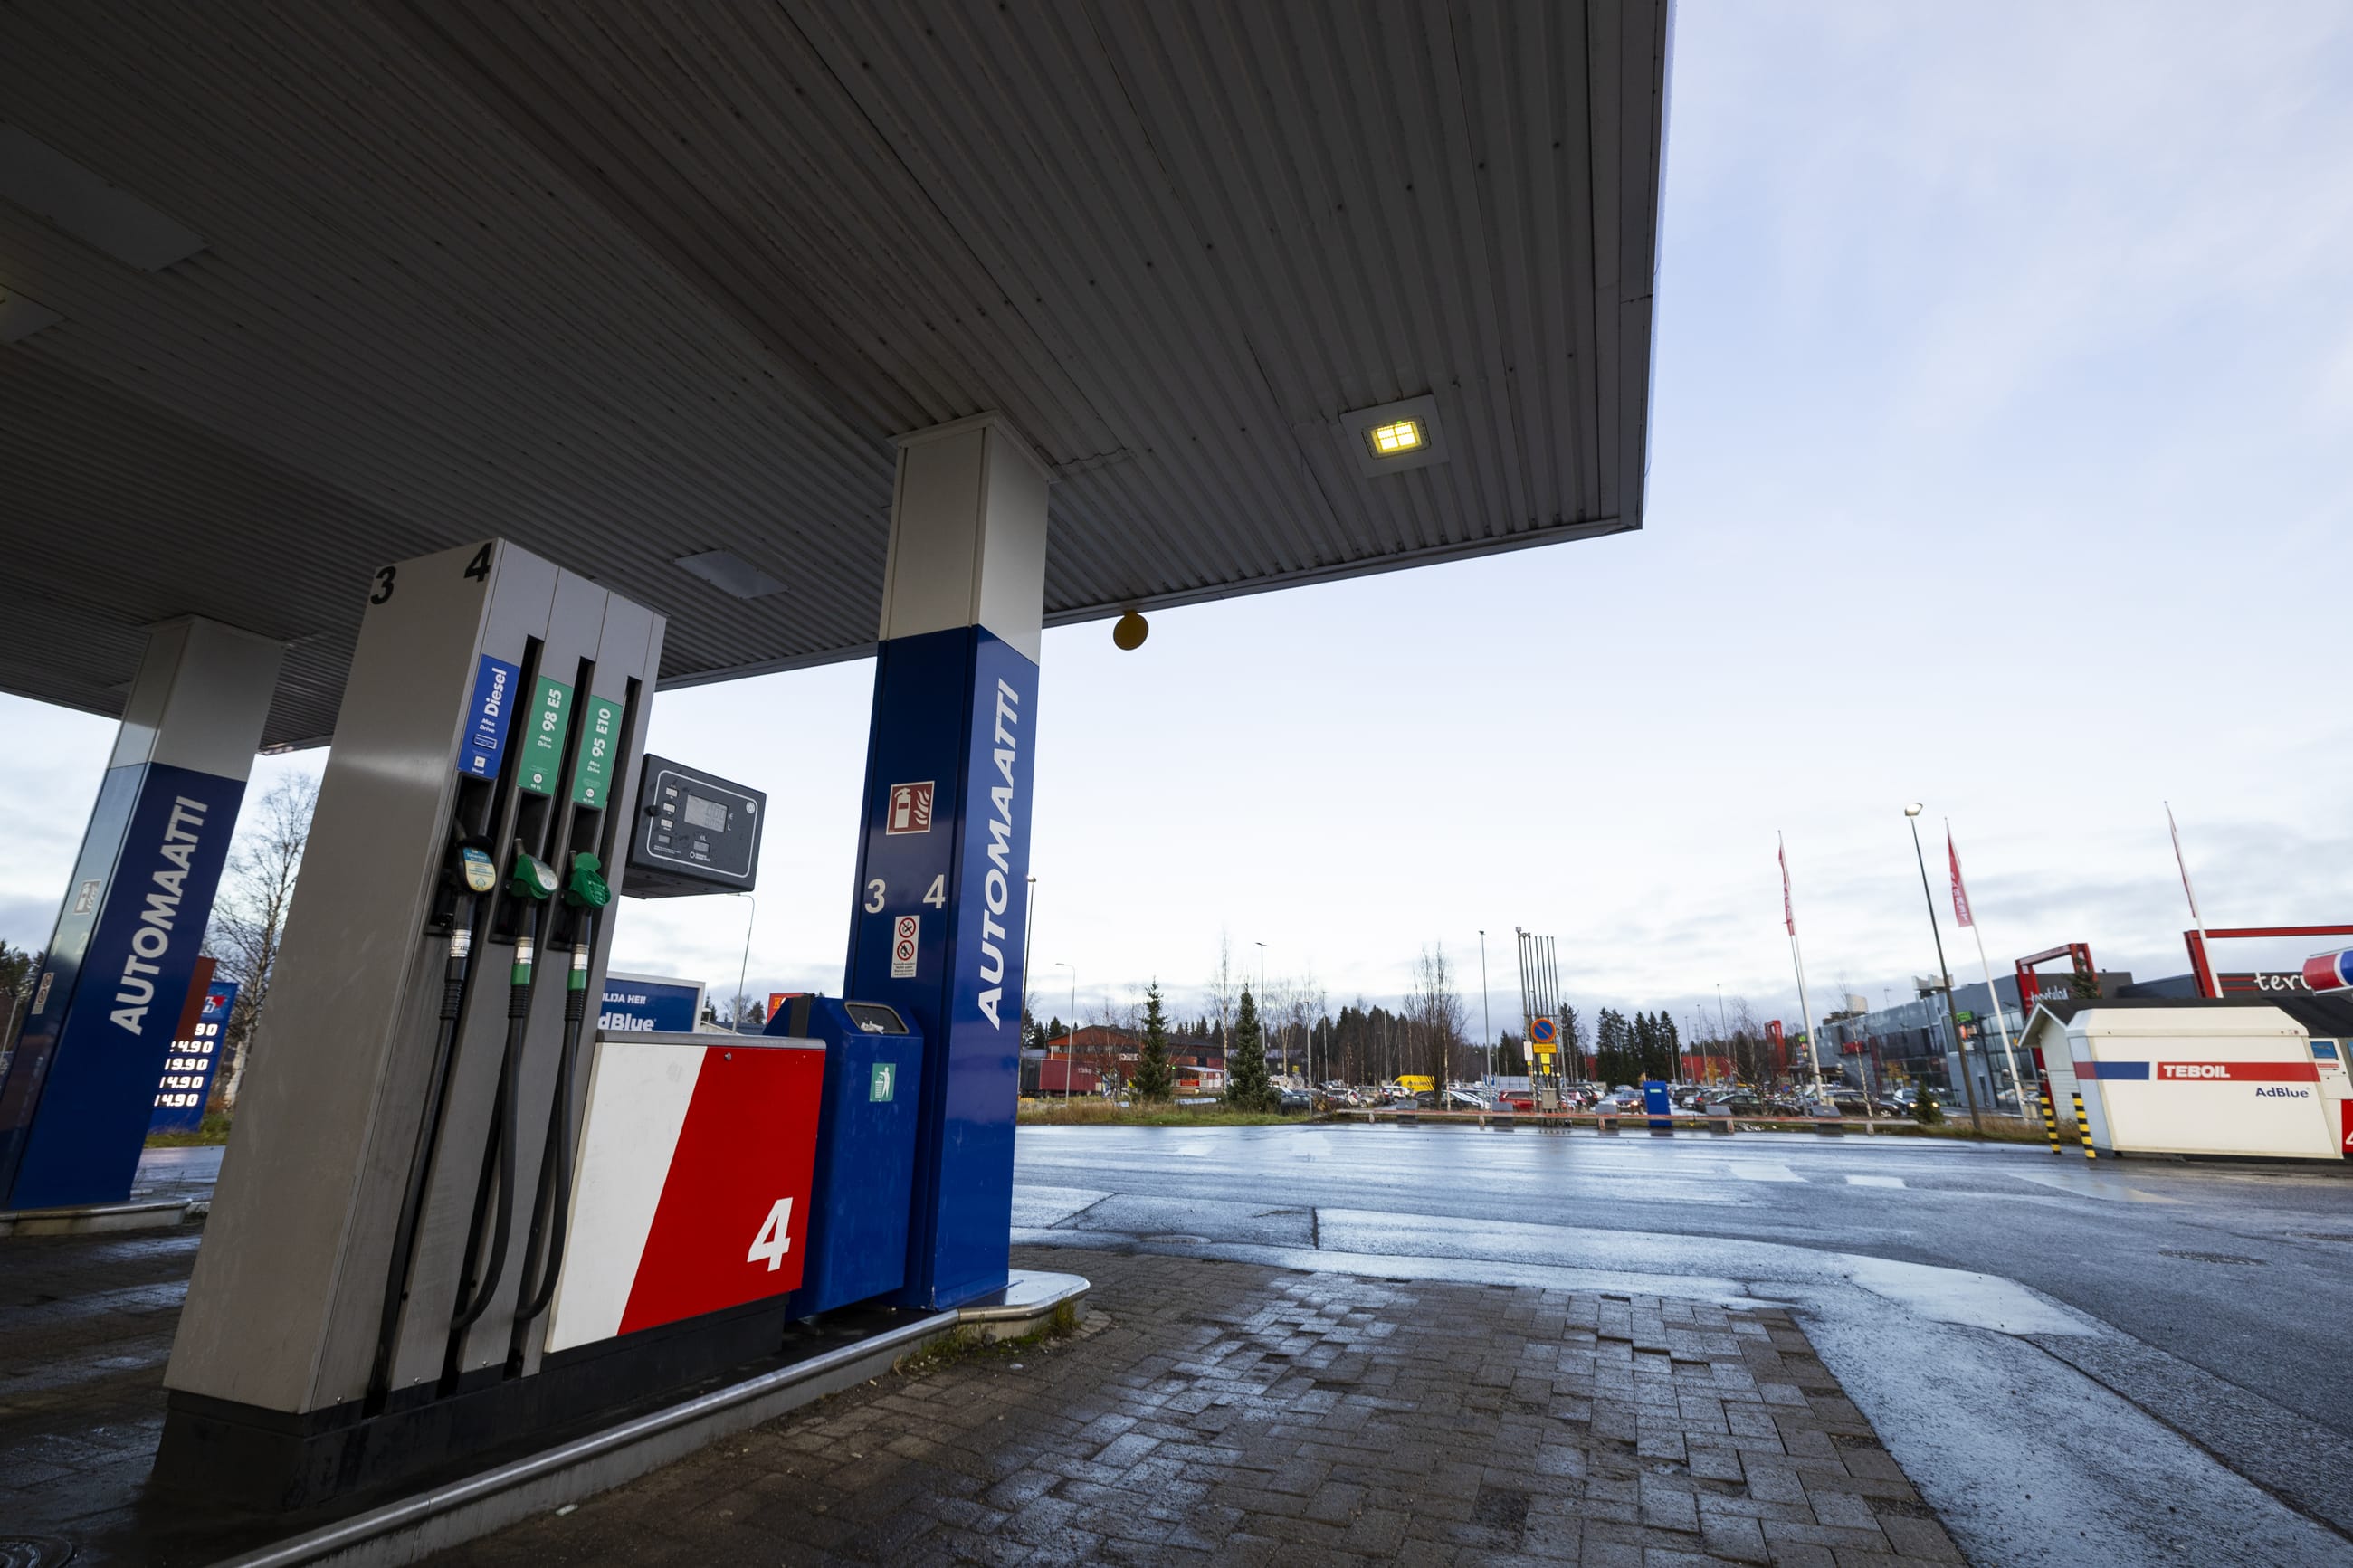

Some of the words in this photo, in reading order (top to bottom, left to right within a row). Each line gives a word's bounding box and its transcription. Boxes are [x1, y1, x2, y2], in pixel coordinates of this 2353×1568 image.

[370, 565, 396, 605] 3
[463, 543, 492, 583] 4
[484, 667, 507, 717] Diesel
[547, 689, 562, 708] E5
[480, 724, 496, 734] Drive
[481, 717, 496, 727] Max
[542, 711, 557, 731] 98
[595, 708, 611, 735] E10
[538, 734, 552, 743] Max
[538, 740, 552, 749] Drive
[592, 738, 606, 757] 95
[977, 678, 1019, 1031] AUTOMAATTI
[864, 879, 886, 914] 3
[923, 874, 946, 909] 4
[110, 795, 208, 1036] AUTOMAATTI
[2163, 1064, 2231, 1079] TEBOIL
[2255, 1087, 2310, 1098] AdBlue
[747, 1196, 794, 1272] 4
